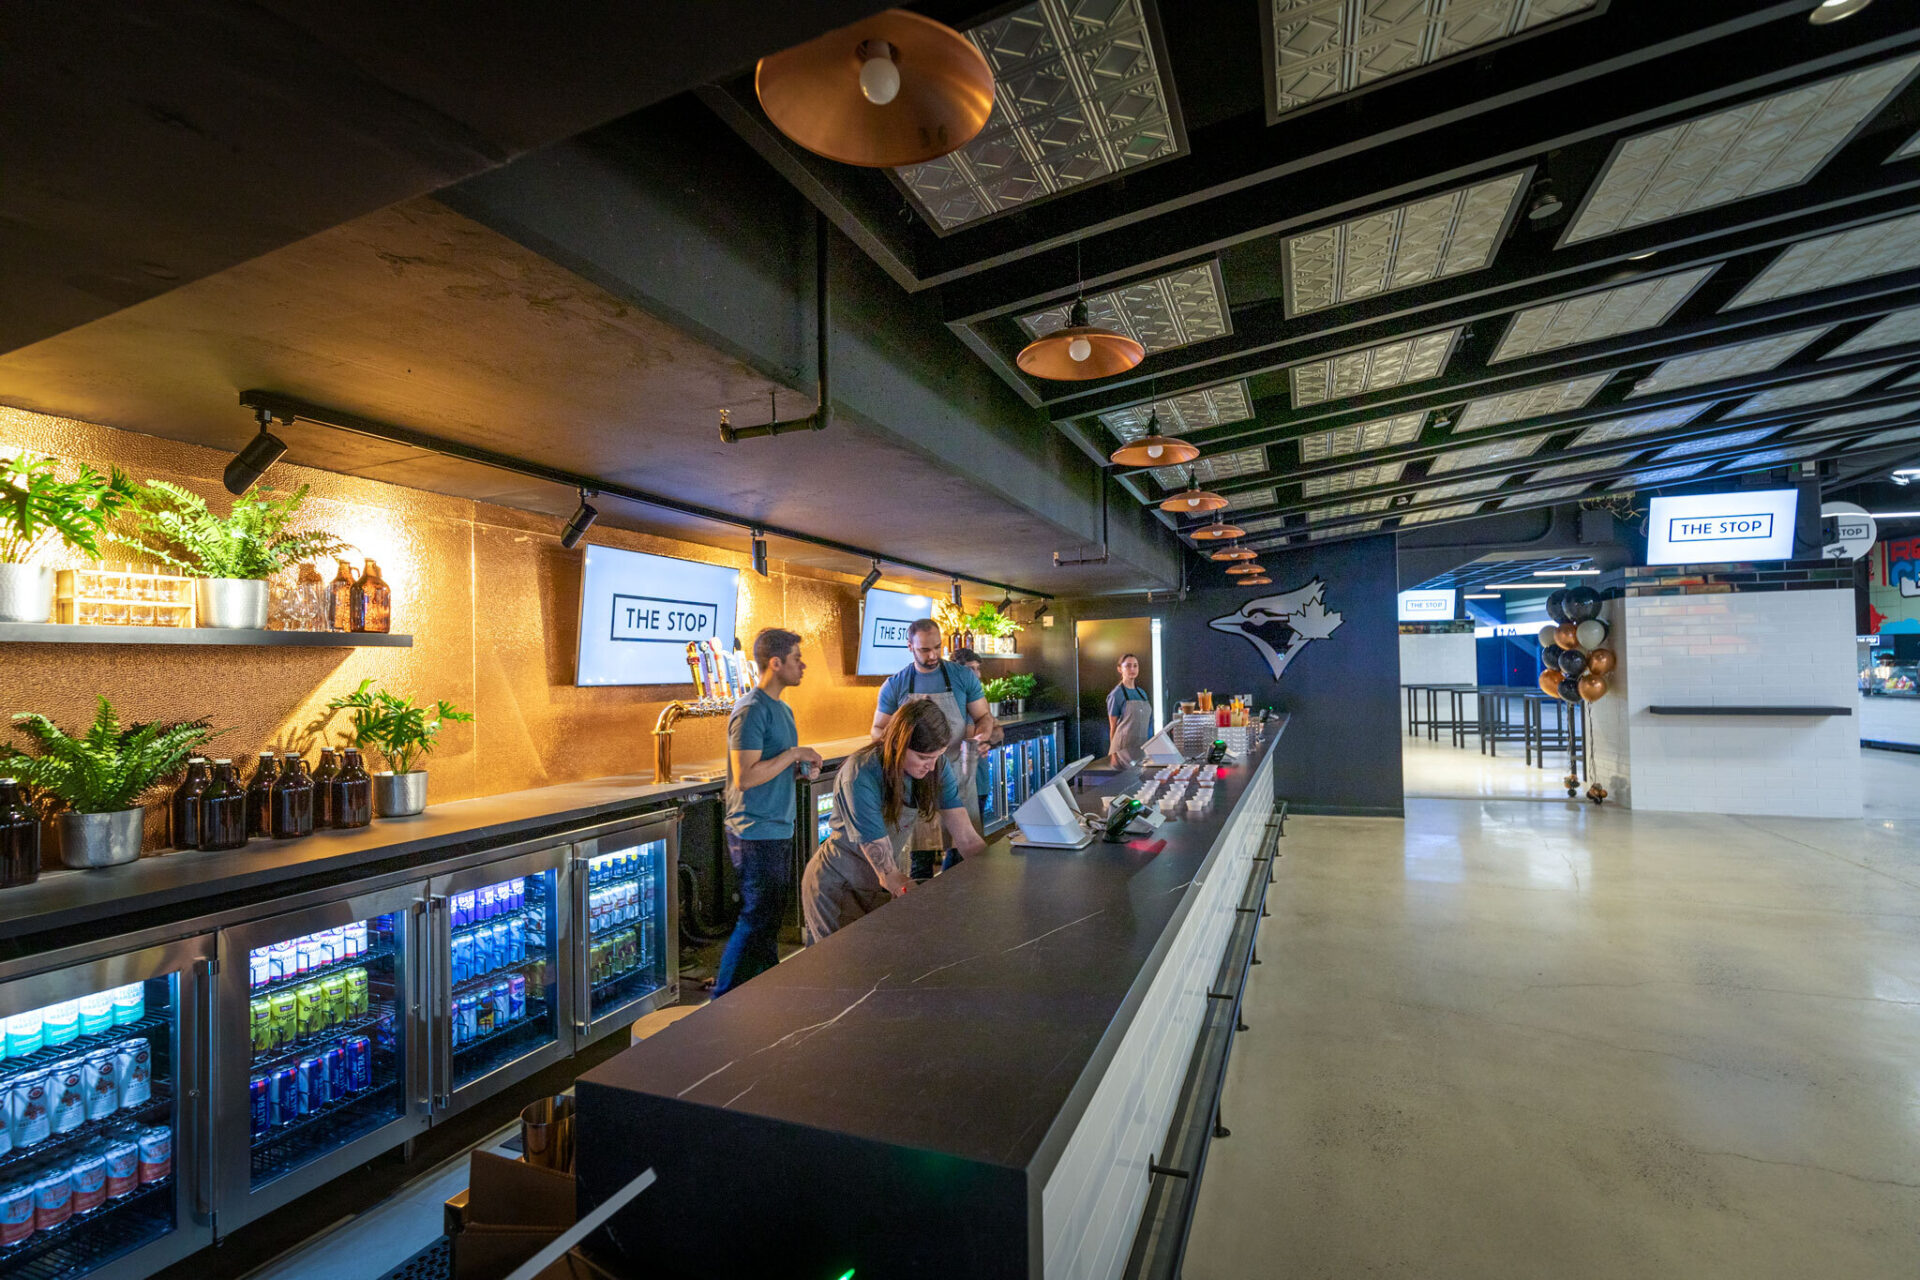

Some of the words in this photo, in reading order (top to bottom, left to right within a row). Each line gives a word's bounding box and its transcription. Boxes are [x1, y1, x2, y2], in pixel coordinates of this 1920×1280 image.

[1682, 523, 1712, 535] THE
[1720, 520, 1762, 534] STOP
[626, 607, 660, 630] THE
[667, 610, 708, 632] STOP
[880, 625, 896, 640] THE
[897, 627, 909, 641] ST
